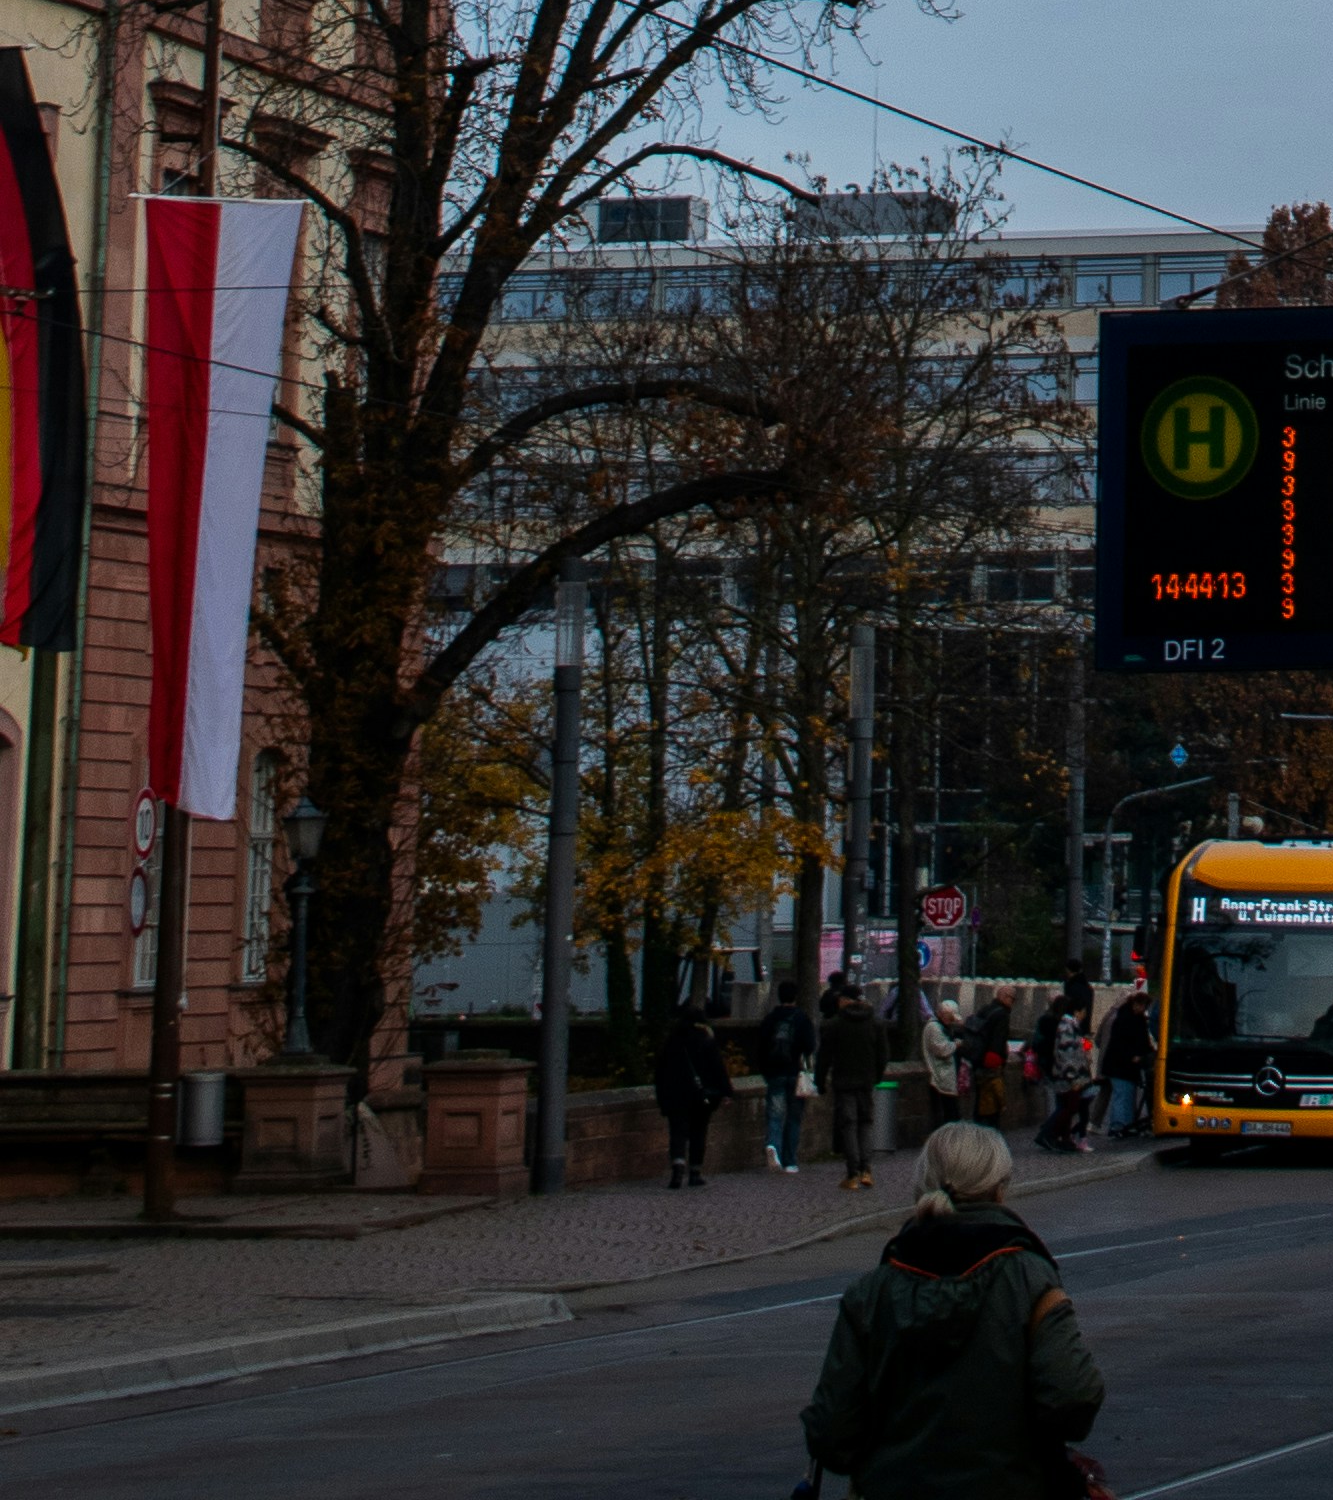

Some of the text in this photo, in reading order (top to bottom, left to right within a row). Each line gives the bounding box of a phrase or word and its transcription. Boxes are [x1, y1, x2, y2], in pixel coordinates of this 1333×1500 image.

[1285, 393, 1327, 411] Linie
[1174, 406, 1225, 470] H
[1281, 426, 1296, 448] 3
[1281, 451, 1296, 472] 9
[1281, 475, 1296, 497] 3
[1281, 500, 1296, 521] 9
[1281, 524, 1295, 546] 3
[1281, 550, 1296, 570] 9
[1151, 572, 1247, 601] 14:44:13
[1281, 573, 1296, 595] 3
[1281, 598, 1296, 620] 9
[1164, 638, 1226, 662] DFI 2
[927, 897, 962, 916] STOP
[1191, 897, 1206, 922] H
